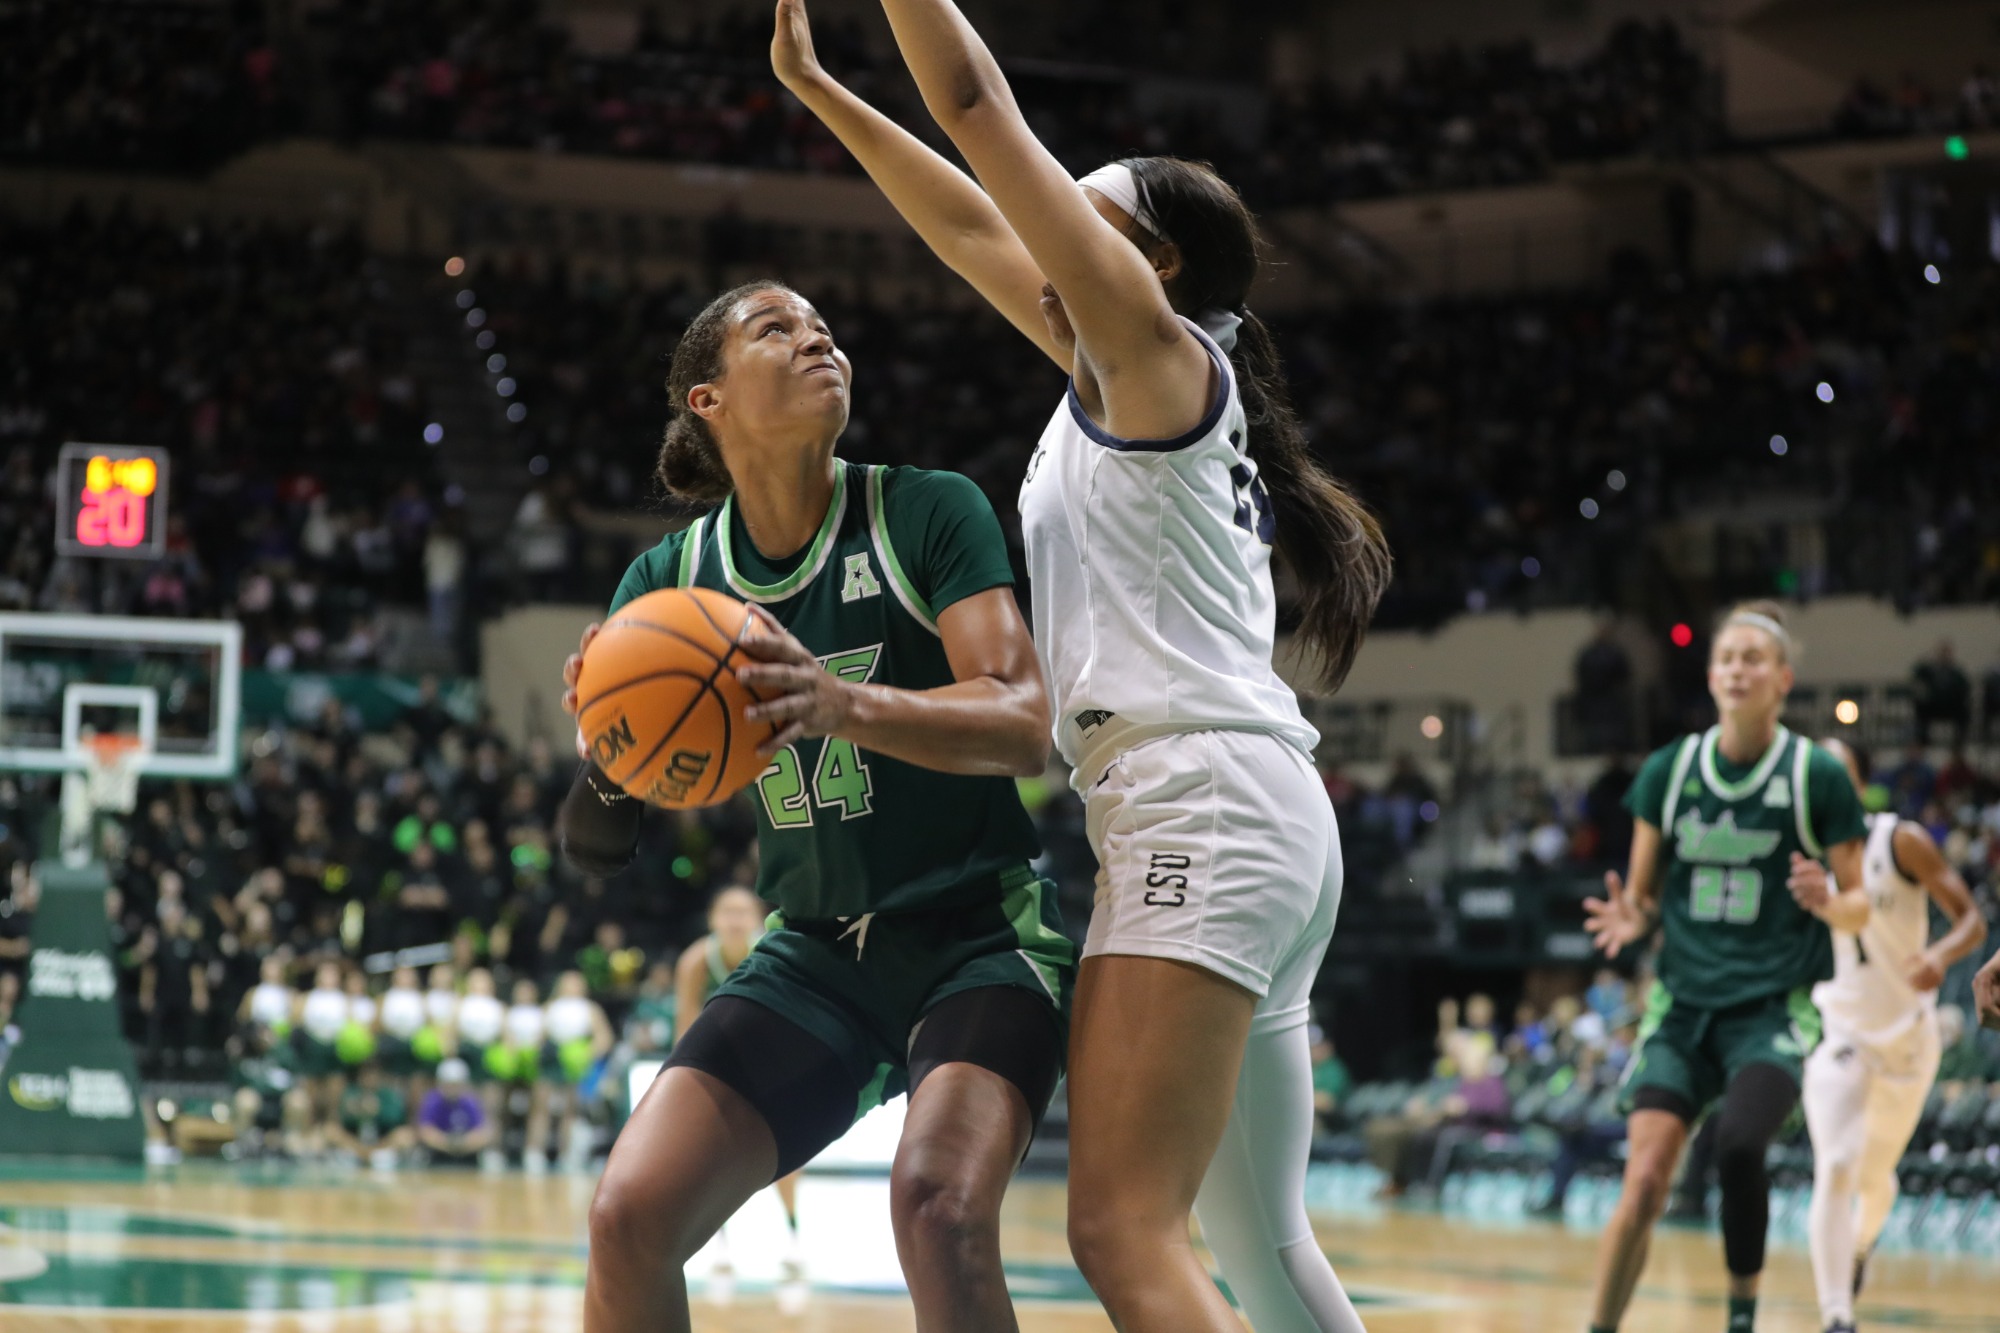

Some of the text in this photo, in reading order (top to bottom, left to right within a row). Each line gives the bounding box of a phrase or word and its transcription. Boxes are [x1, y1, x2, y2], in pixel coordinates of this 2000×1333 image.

[77, 488, 146, 547] 20
[755, 735, 874, 829] 24
[1143, 853, 1191, 908] CSU
[1690, 866, 1763, 925] 23
